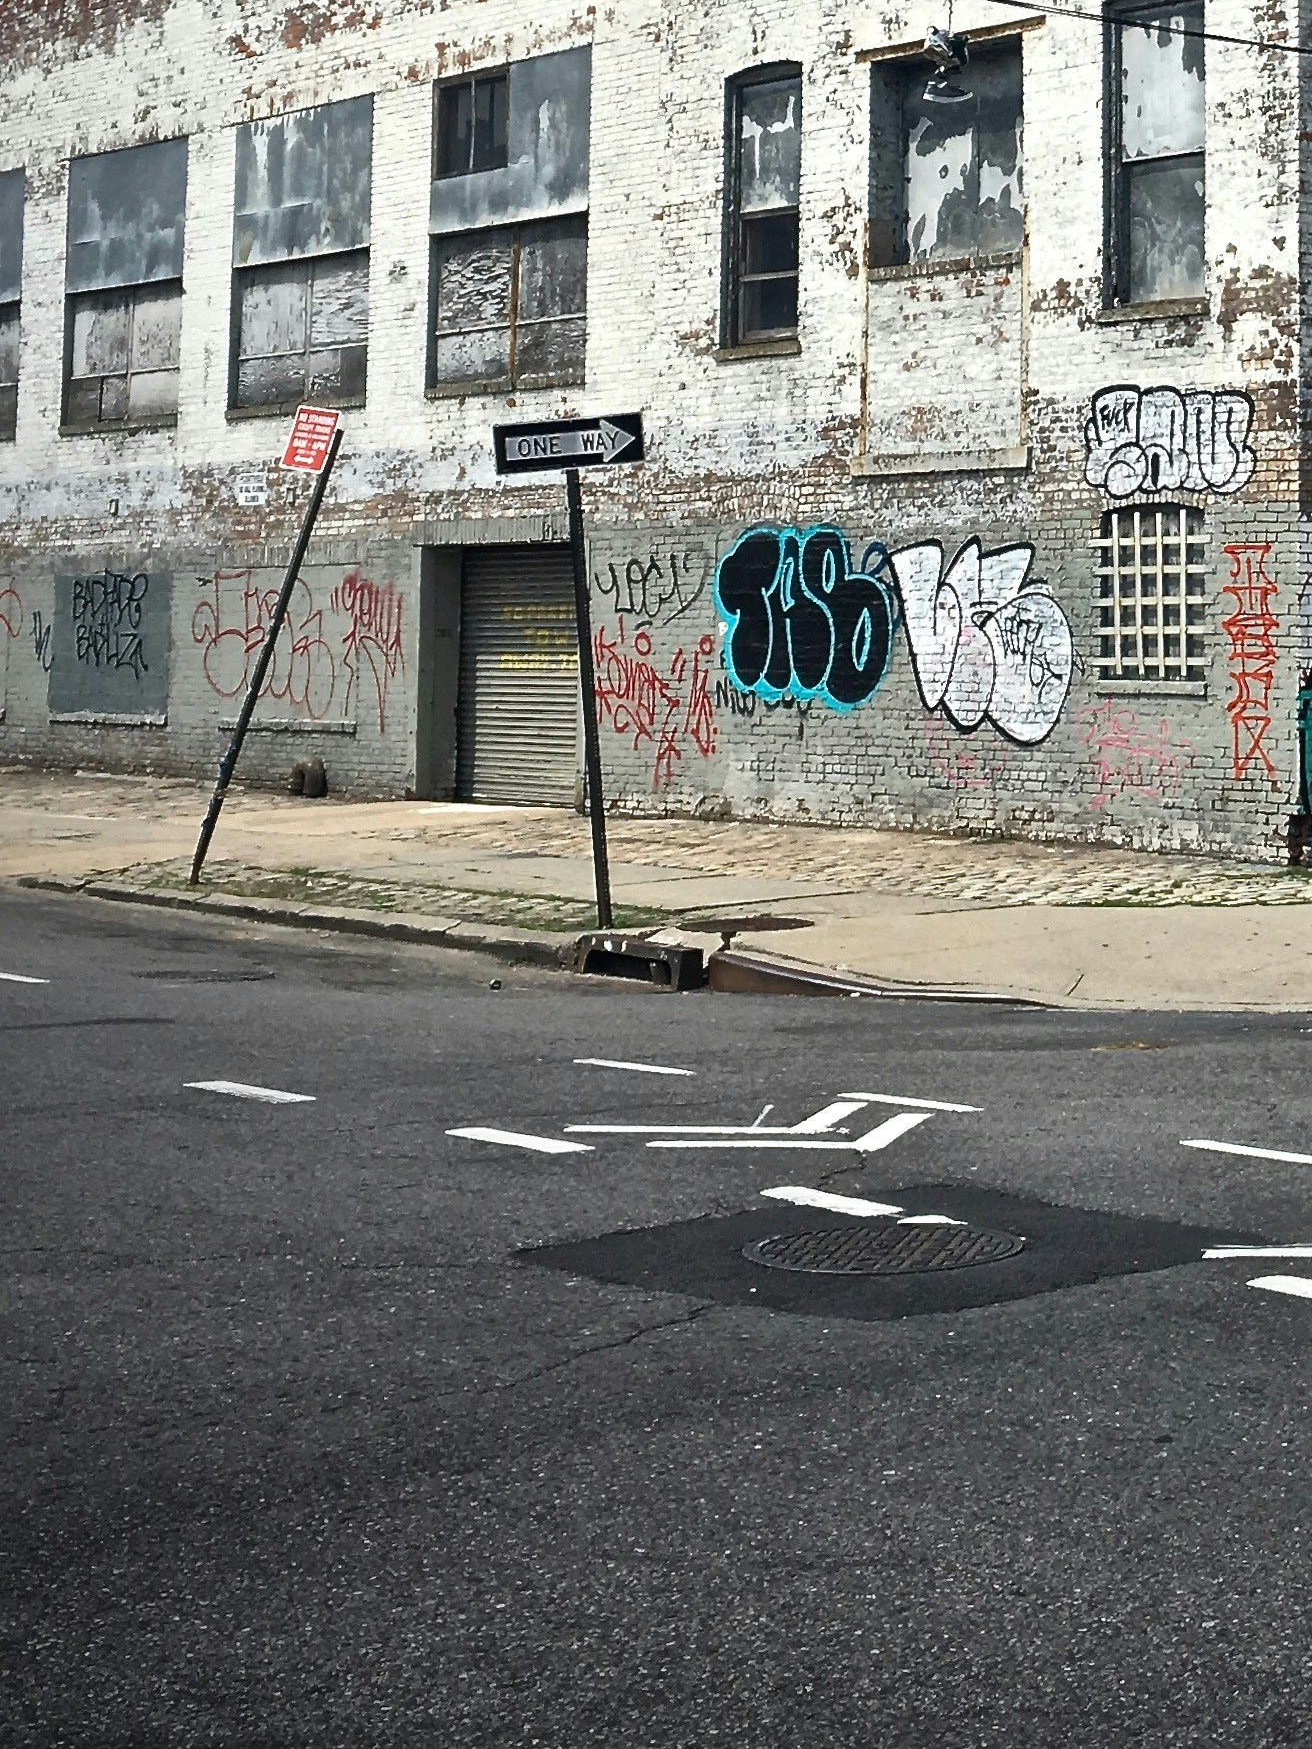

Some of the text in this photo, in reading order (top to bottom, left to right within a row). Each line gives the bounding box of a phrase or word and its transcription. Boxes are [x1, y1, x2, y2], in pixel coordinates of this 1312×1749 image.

[1100, 398, 1136, 433] FUCK
[517, 430, 620, 458] ONE WAY
